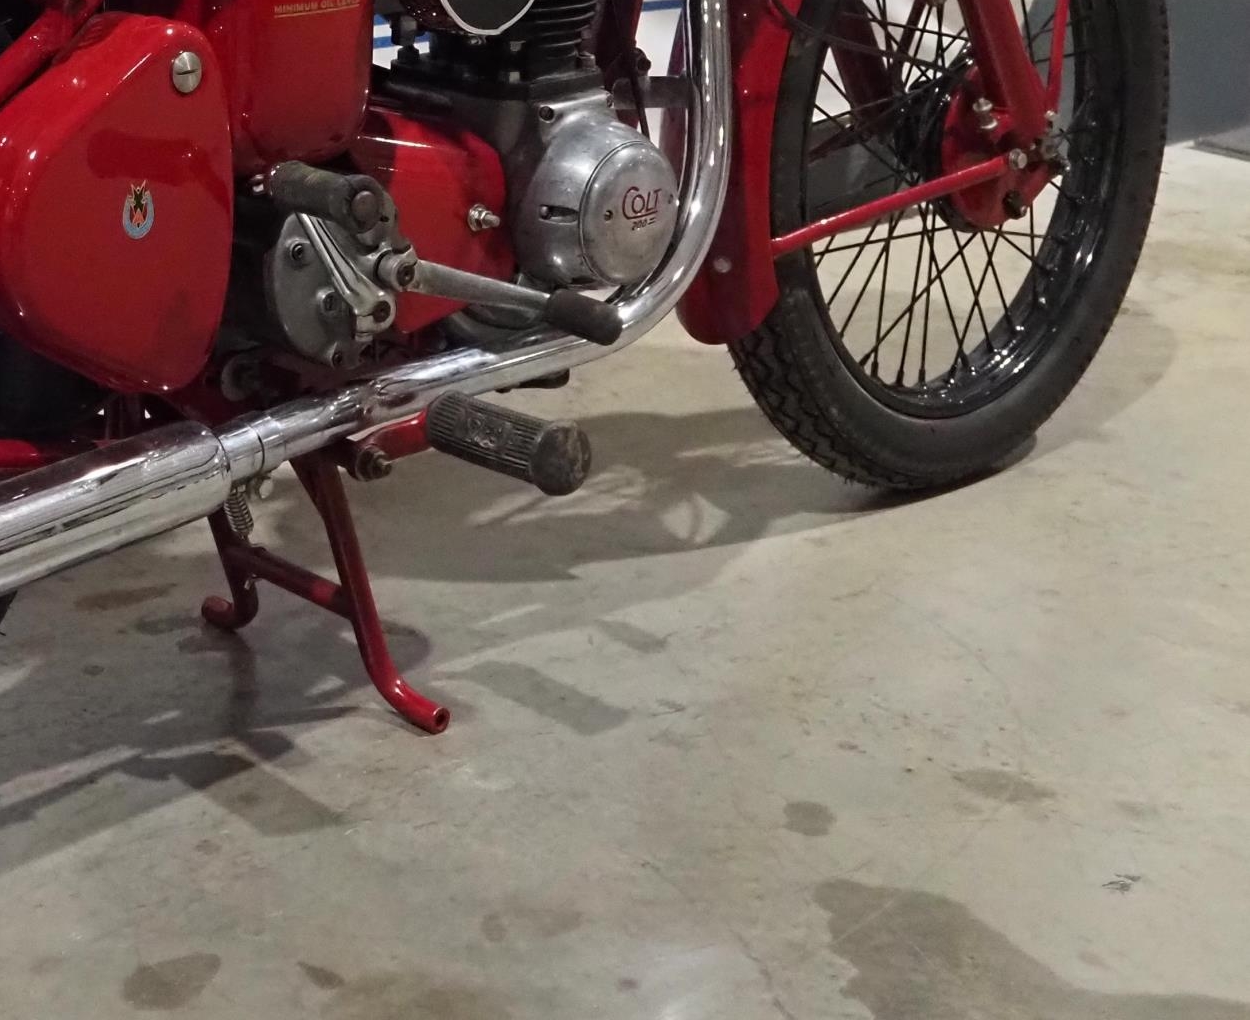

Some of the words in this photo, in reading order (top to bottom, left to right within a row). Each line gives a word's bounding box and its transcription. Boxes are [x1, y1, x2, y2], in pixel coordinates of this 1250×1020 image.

[274, 1, 318, 14] MINIMUM
[320, 0, 334, 9] OIL
[622, 186, 662, 220] COLT
